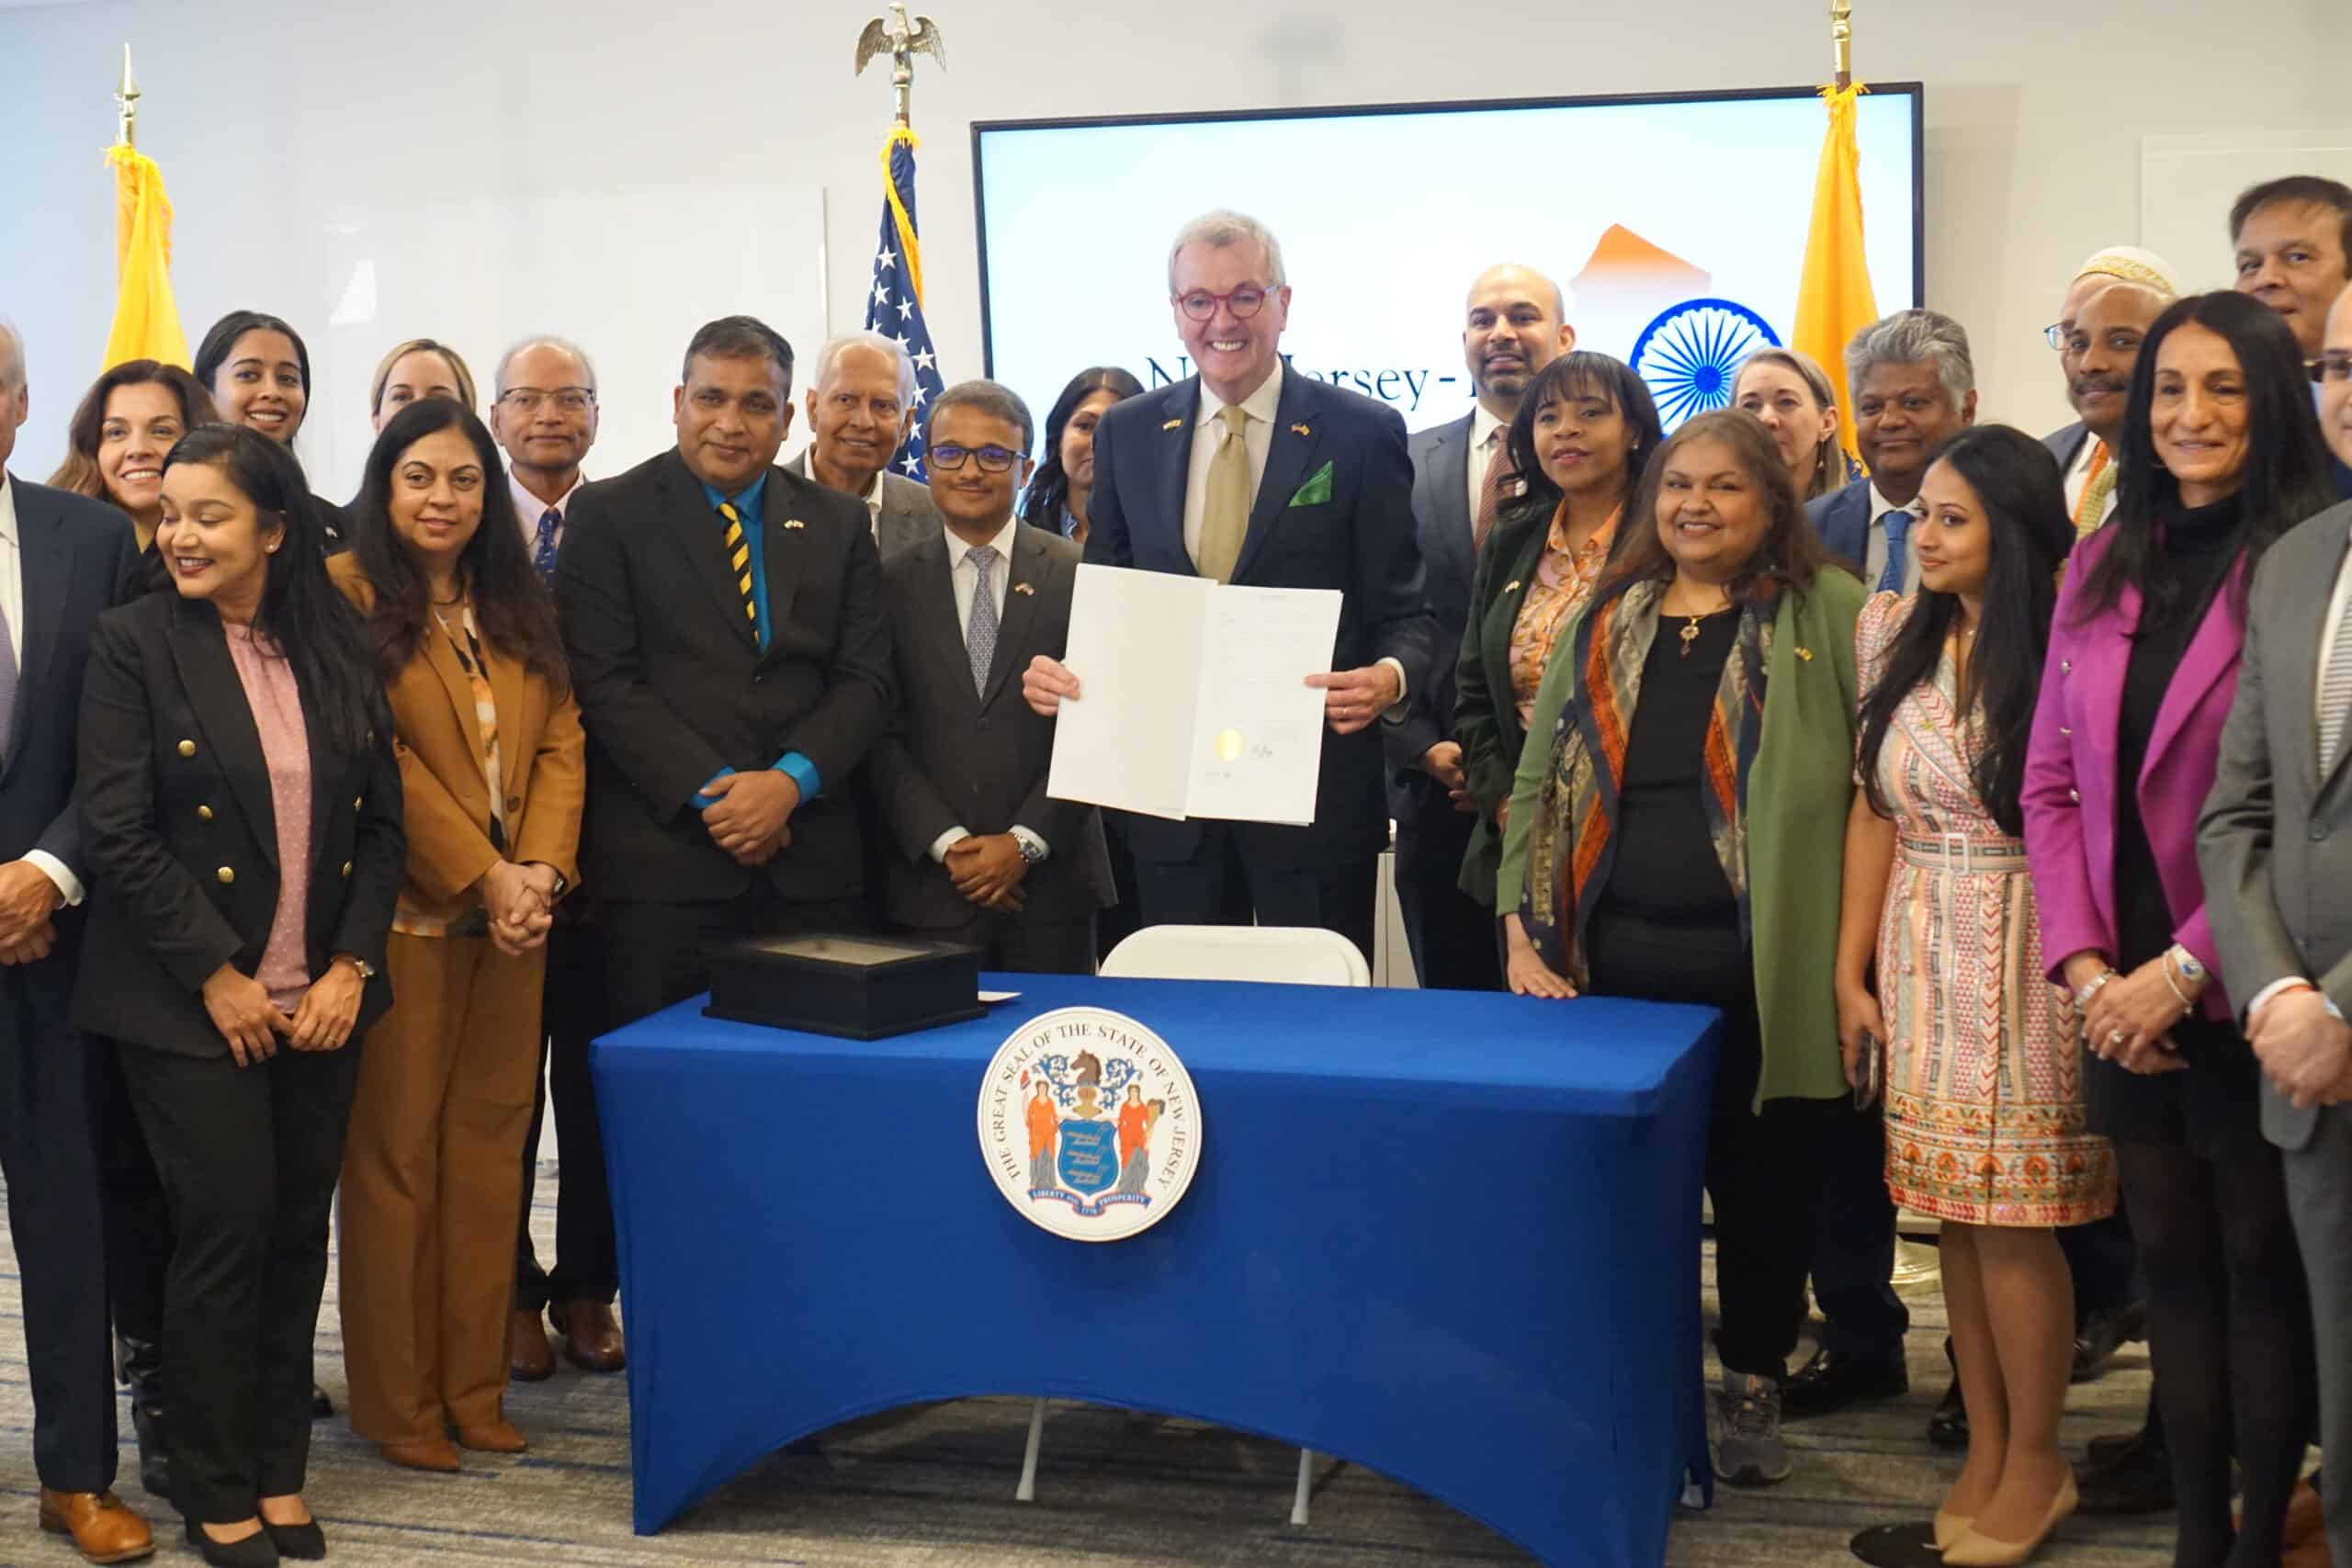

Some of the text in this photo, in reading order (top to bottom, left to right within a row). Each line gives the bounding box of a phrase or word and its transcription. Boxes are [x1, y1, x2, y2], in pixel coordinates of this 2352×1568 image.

[992, 1023, 1187, 1190] THE GREAT SEAL OF THE STATE OF NEW JERSEY
